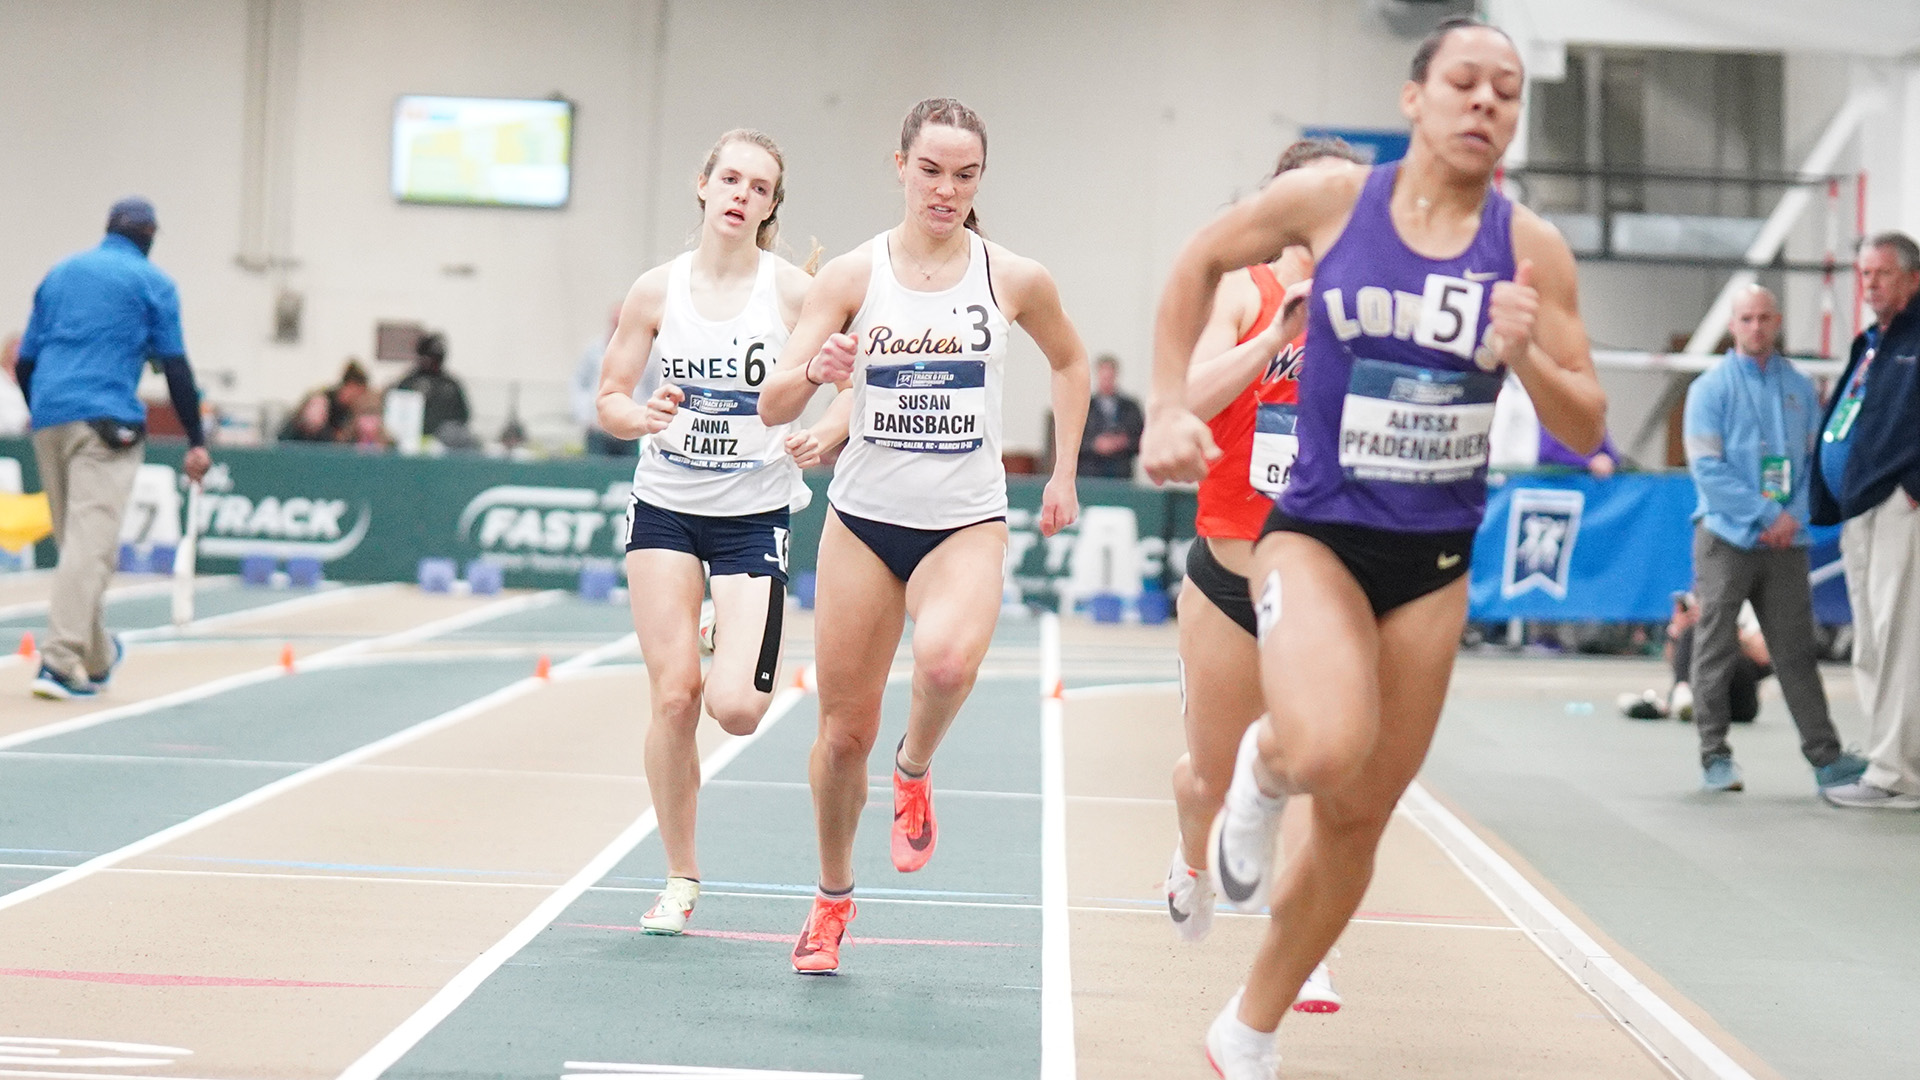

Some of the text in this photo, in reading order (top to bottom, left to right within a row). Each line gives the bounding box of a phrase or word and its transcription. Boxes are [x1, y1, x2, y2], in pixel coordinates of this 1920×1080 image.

[966, 304, 992, 352] 3
[1432, 284, 1468, 343] 5
[865, 325, 963, 357] Roches
[661, 357, 738, 379] GENES
[744, 341, 767, 387] 6
[898, 394, 951, 411] SUSAN
[691, 417, 730, 435] ANNA
[873, 411, 976, 435] BANSBACH
[683, 433, 739, 456] FLAITZ
[134, 502, 158, 544] 7
[195, 493, 348, 539] TRACK
[479, 507, 607, 549] FAST
